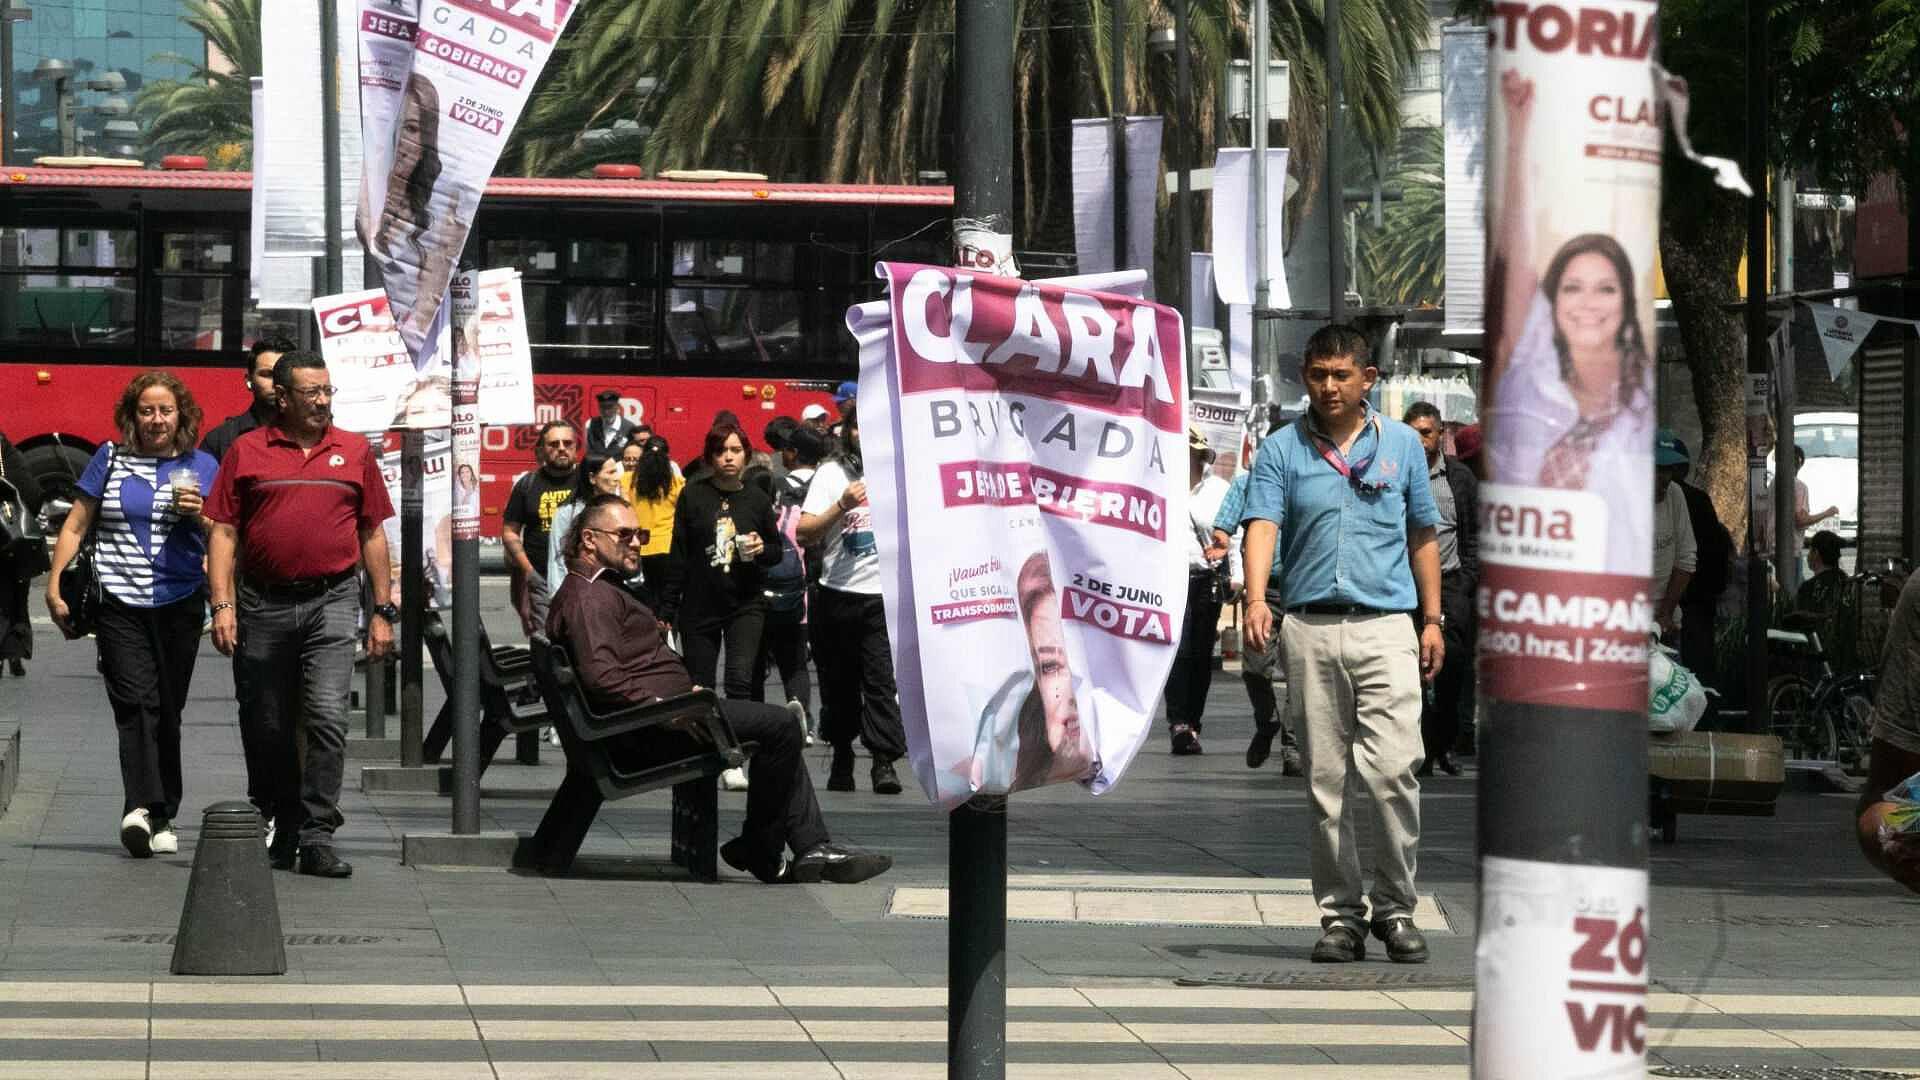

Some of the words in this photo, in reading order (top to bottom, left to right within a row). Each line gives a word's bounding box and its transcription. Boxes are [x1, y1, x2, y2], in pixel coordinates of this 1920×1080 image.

[368, 15, 410, 38] JEFA
[1488, 3, 1653, 60] TORI
[424, 37, 522, 85] GOBIERNO
[465, 98, 477, 107] DE
[1588, 95, 1656, 127] CLA
[455, 104, 498, 135] VOTA
[324, 303, 399, 334] CL
[902, 268, 1176, 404] CLARA
[930, 400, 1165, 474] BRIGADA
[1030, 477, 1163, 532] BIERNO
[950, 586, 977, 601] QUE
[1073, 574, 1083, 586] 2
[1088, 579, 1113, 596] DE
[1116, 586, 1163, 607] JUNIO
[1070, 591, 1166, 641] VOTA
